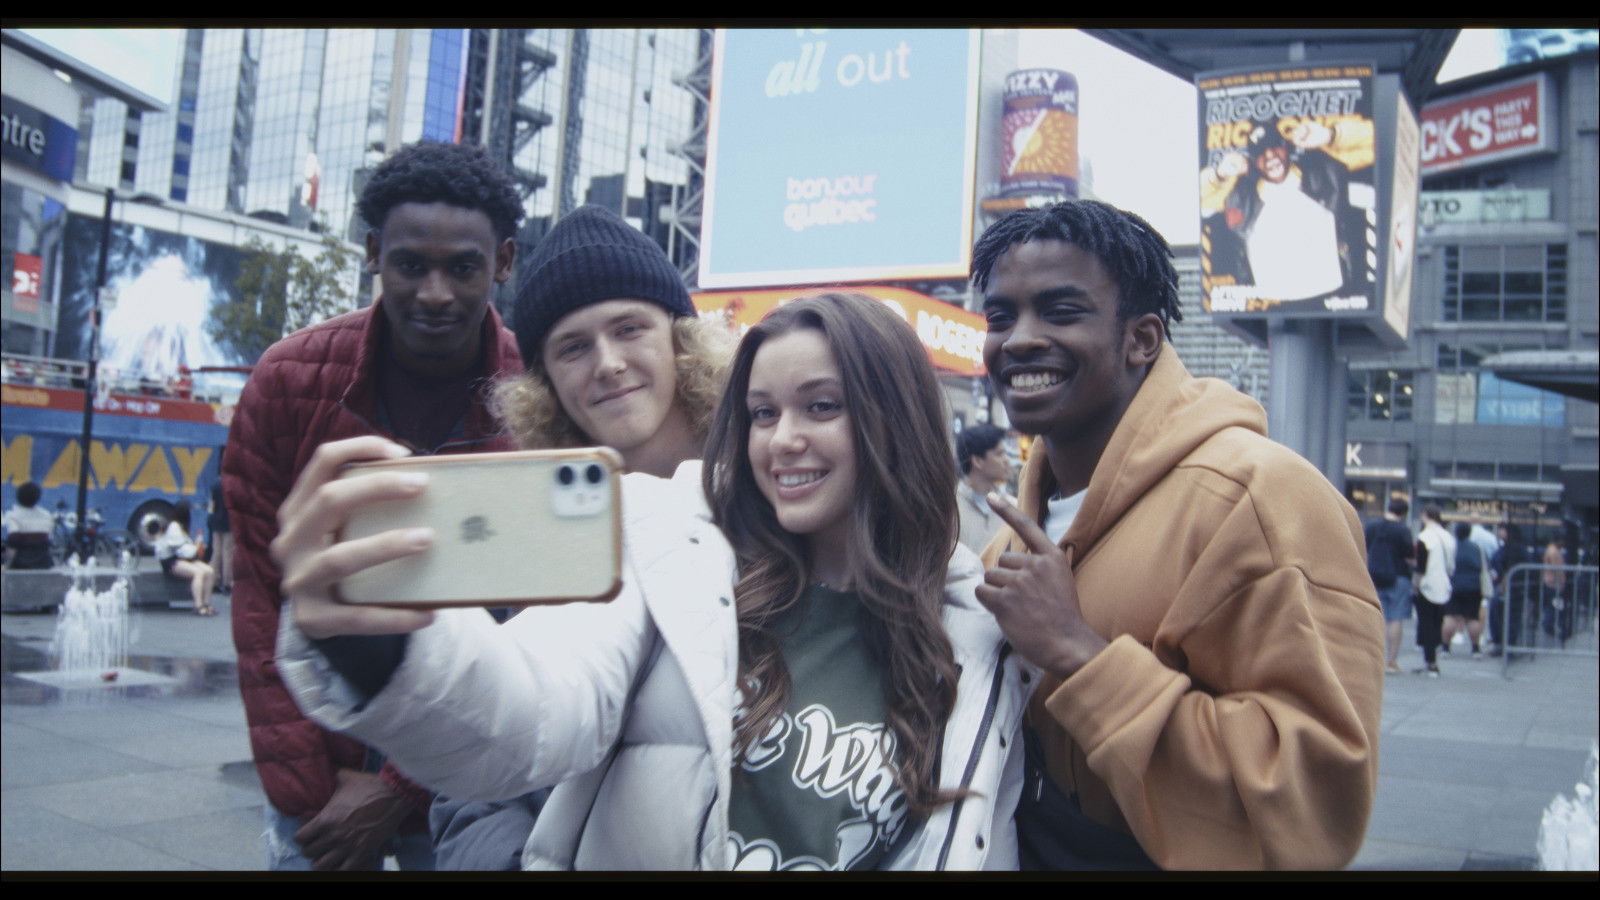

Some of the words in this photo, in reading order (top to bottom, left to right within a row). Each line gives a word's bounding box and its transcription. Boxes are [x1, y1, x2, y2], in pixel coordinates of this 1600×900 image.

[766, 41, 828, 97] all
[837, 40, 912, 87] out
[1207, 91, 1361, 125] RICOCHET
[786, 173, 878, 200] bonjour
[42, 438, 212, 494] AWAY
